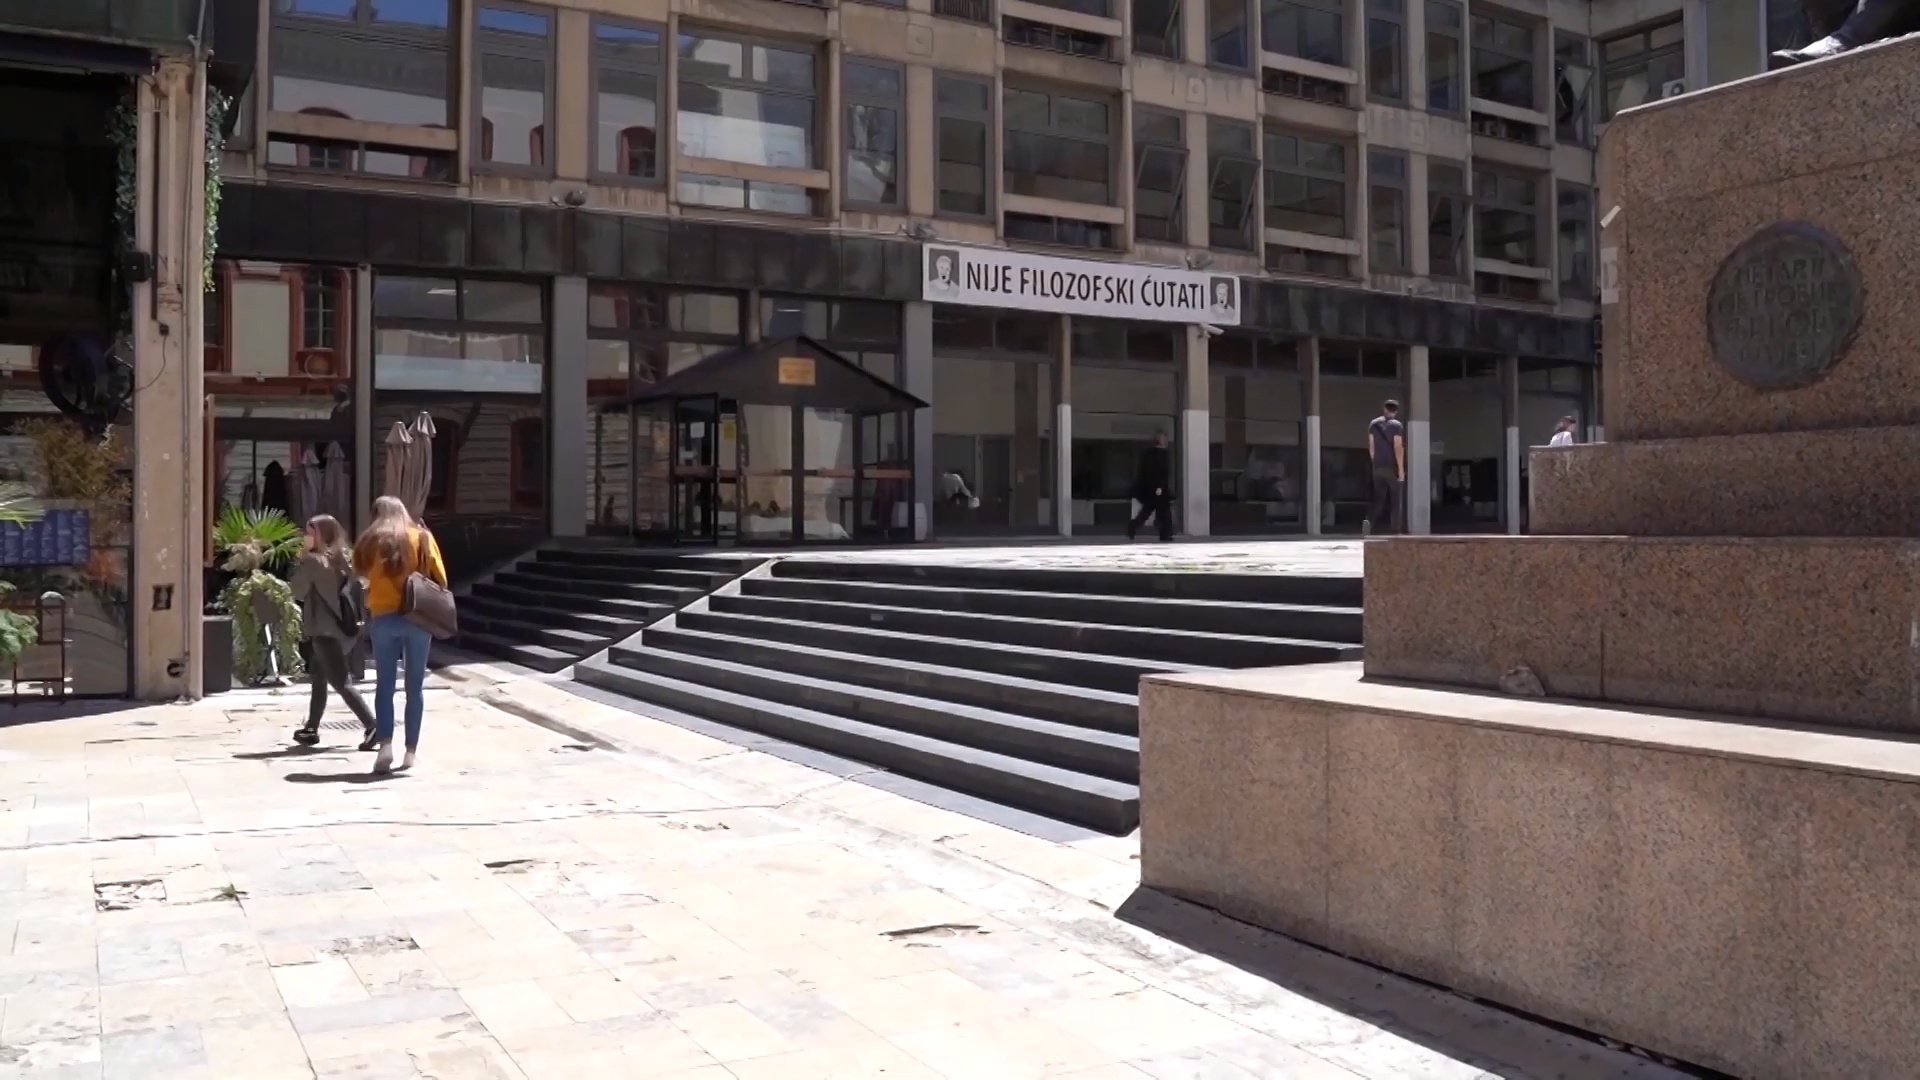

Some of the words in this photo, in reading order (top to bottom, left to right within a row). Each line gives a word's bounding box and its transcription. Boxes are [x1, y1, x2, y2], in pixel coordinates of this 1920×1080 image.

[966, 261, 1012, 294] NIJE
[1019, 267, 1135, 305] FILOZOFSKI
[1141, 274, 1205, 310] ĆUTATI
